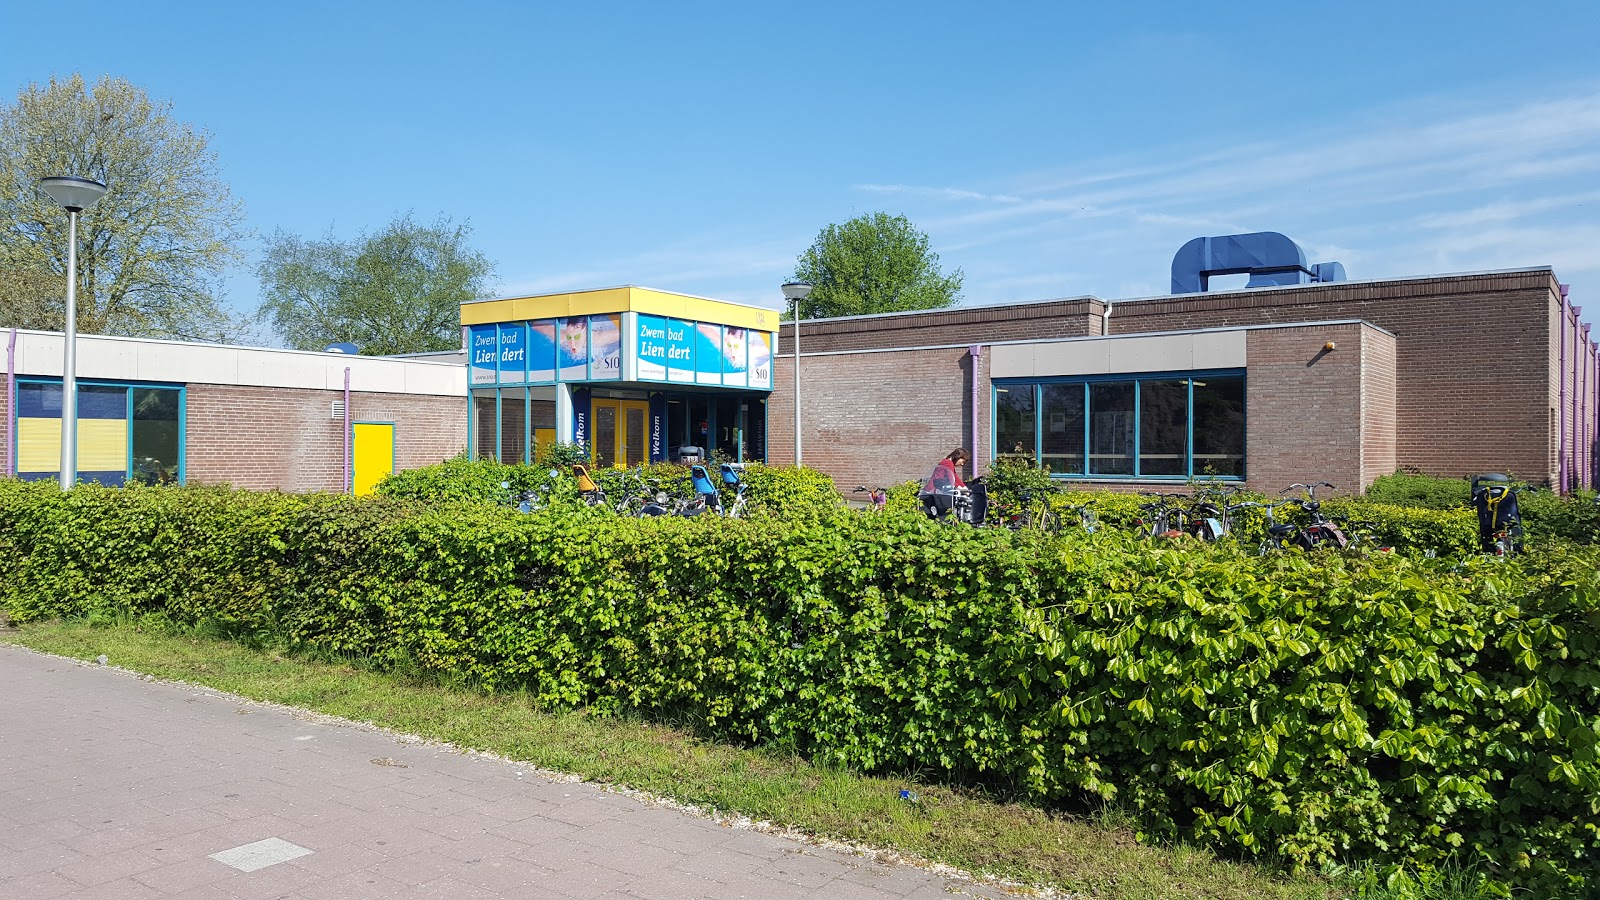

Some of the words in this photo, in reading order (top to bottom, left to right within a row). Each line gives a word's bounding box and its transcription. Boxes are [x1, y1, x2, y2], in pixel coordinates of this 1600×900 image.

[640, 341, 665, 357] Lien
[668, 343, 690, 360] dert
[652, 415, 660, 456] Welkom
